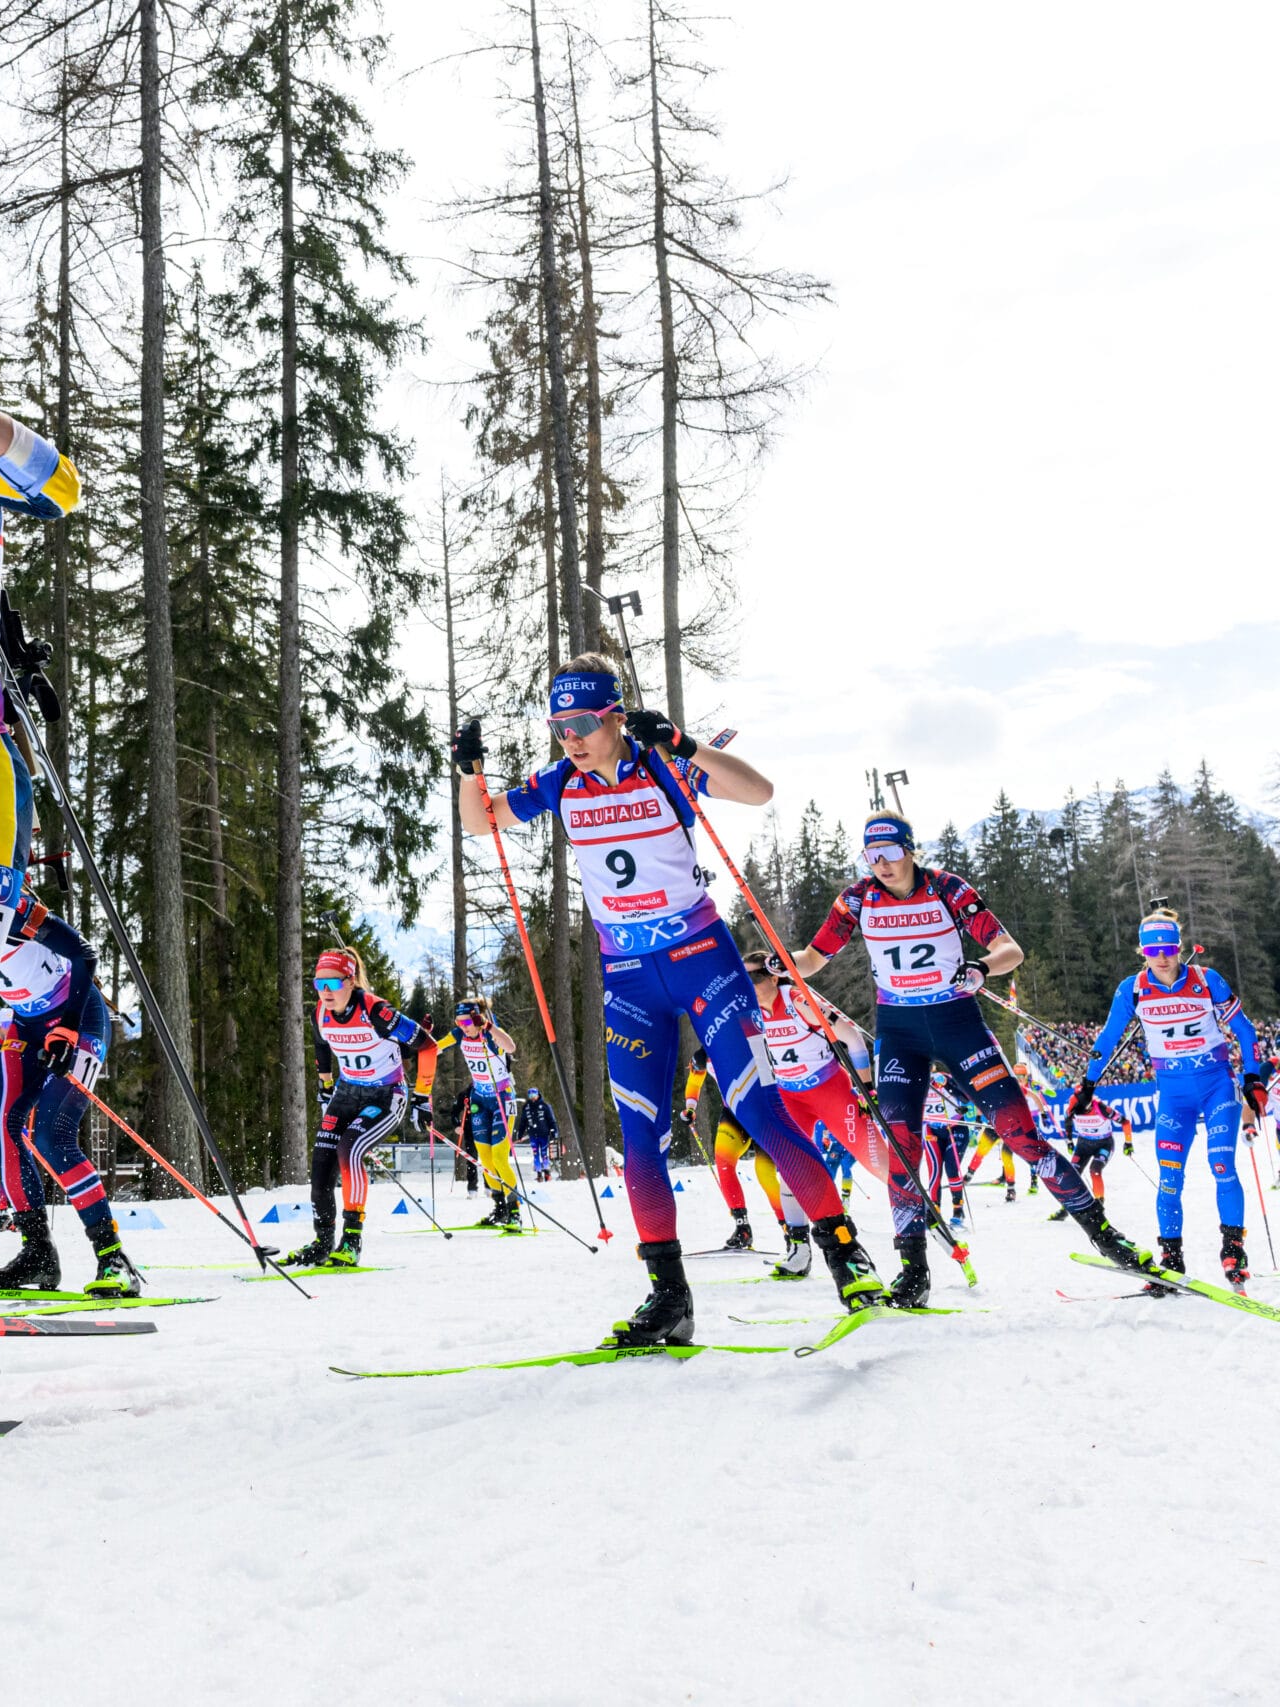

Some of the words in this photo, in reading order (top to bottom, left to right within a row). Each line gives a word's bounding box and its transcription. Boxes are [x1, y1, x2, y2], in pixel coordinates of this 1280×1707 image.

[571, 800, 660, 827] BAUHAUS
[605, 849, 636, 889] 9
[692, 864, 702, 887] 9
[868, 910, 942, 928] BAUHAUS
[883, 943, 936, 970] 12
[701, 974, 725, 998] CAISSE
[614, 996, 649, 1017] Auvergne-
[704, 1000, 741, 1047] CRAFT
[767, 1026, 797, 1038] HAUS
[605, 1027, 653, 1060] omfy
[81, 1056, 98, 1091] 11
[468, 1060, 487, 1073] 20
[925, 1104, 944, 1114] 26
[844, 1103, 857, 1143] odlo
